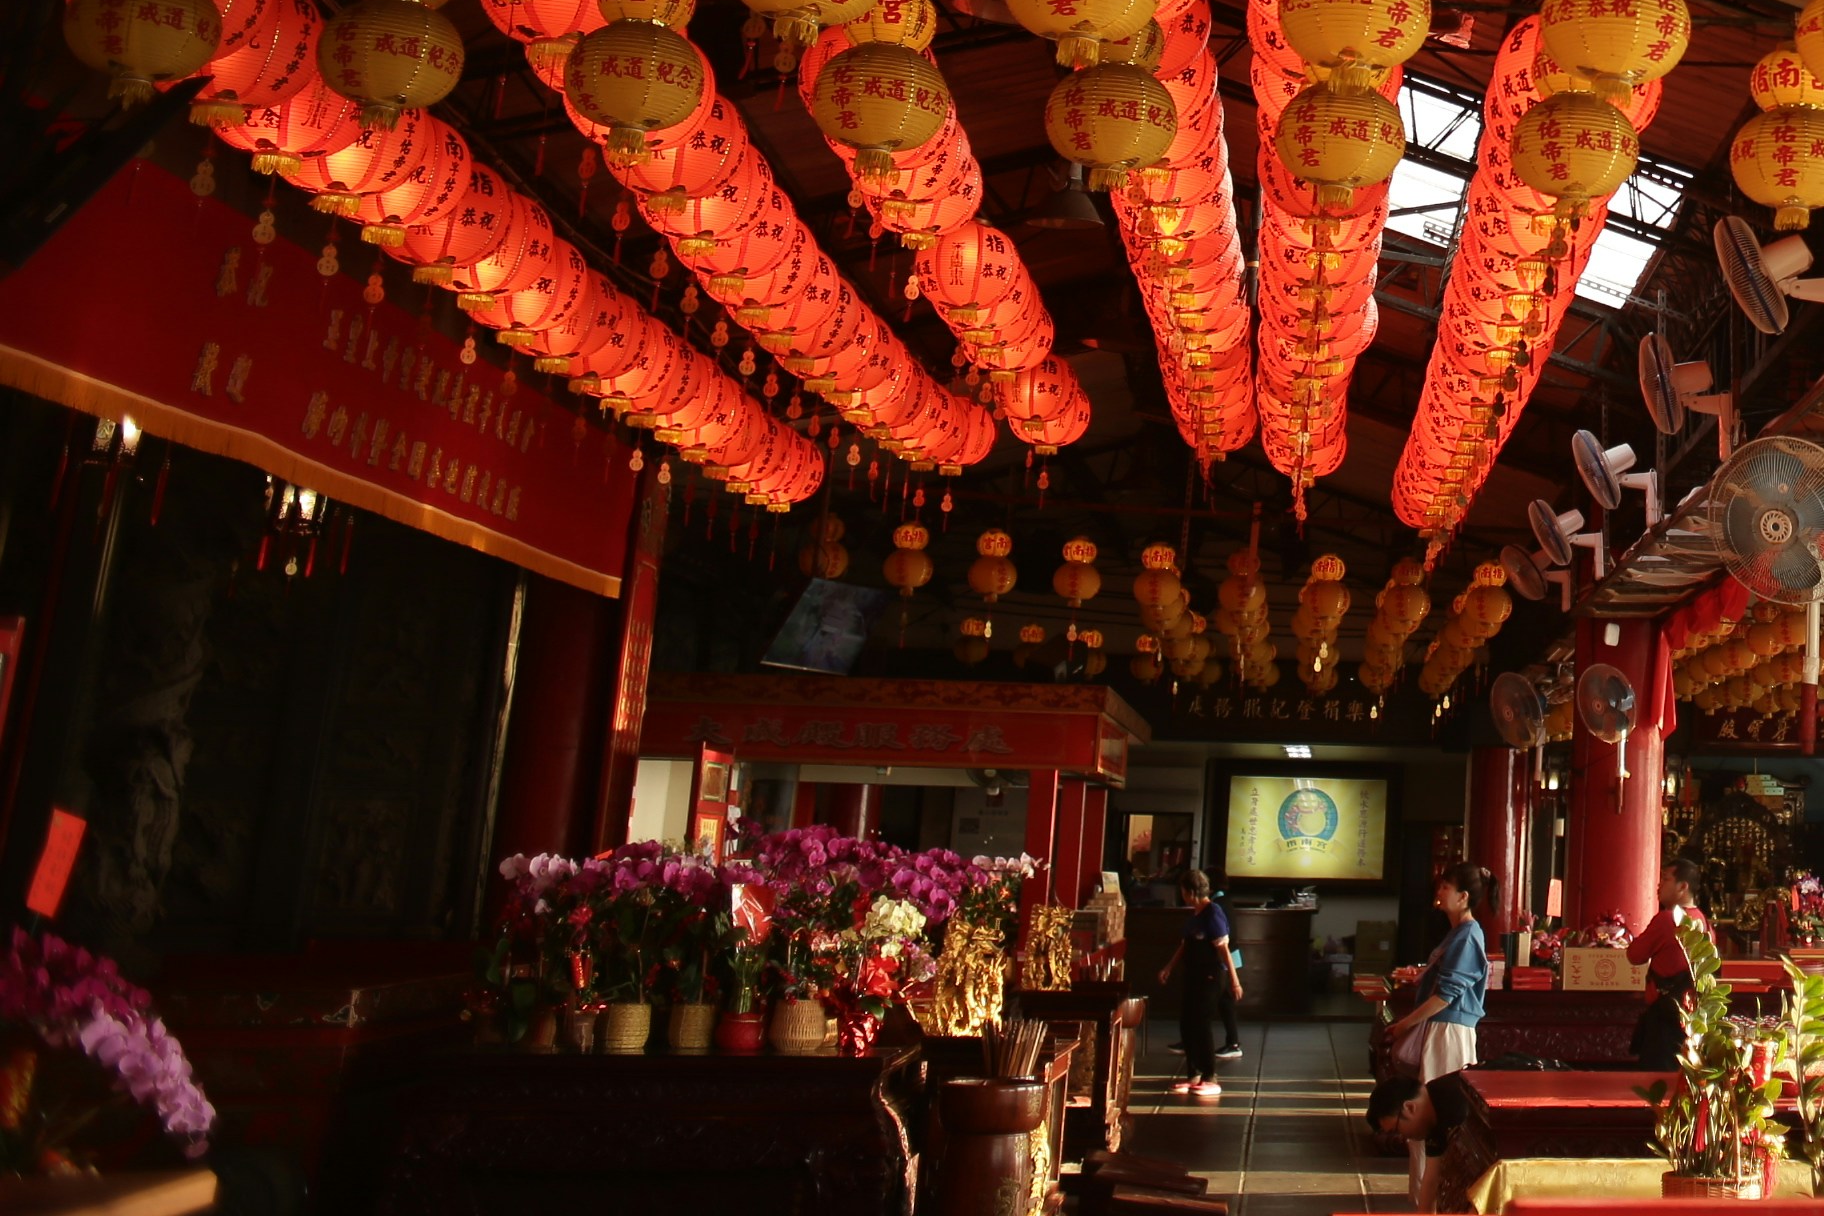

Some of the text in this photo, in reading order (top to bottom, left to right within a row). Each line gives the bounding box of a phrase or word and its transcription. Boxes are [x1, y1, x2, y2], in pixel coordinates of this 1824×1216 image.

[601, 57, 696, 89] 成道紀念
[690, 131, 725, 155] 恭祝
[472, 175, 494, 198] 指
[459, 207, 495, 230] 恭祝
[755, 221, 785, 241] 恭祝
[987, 235, 1004, 254] 指
[982, 263, 1006, 280] 恭祝
